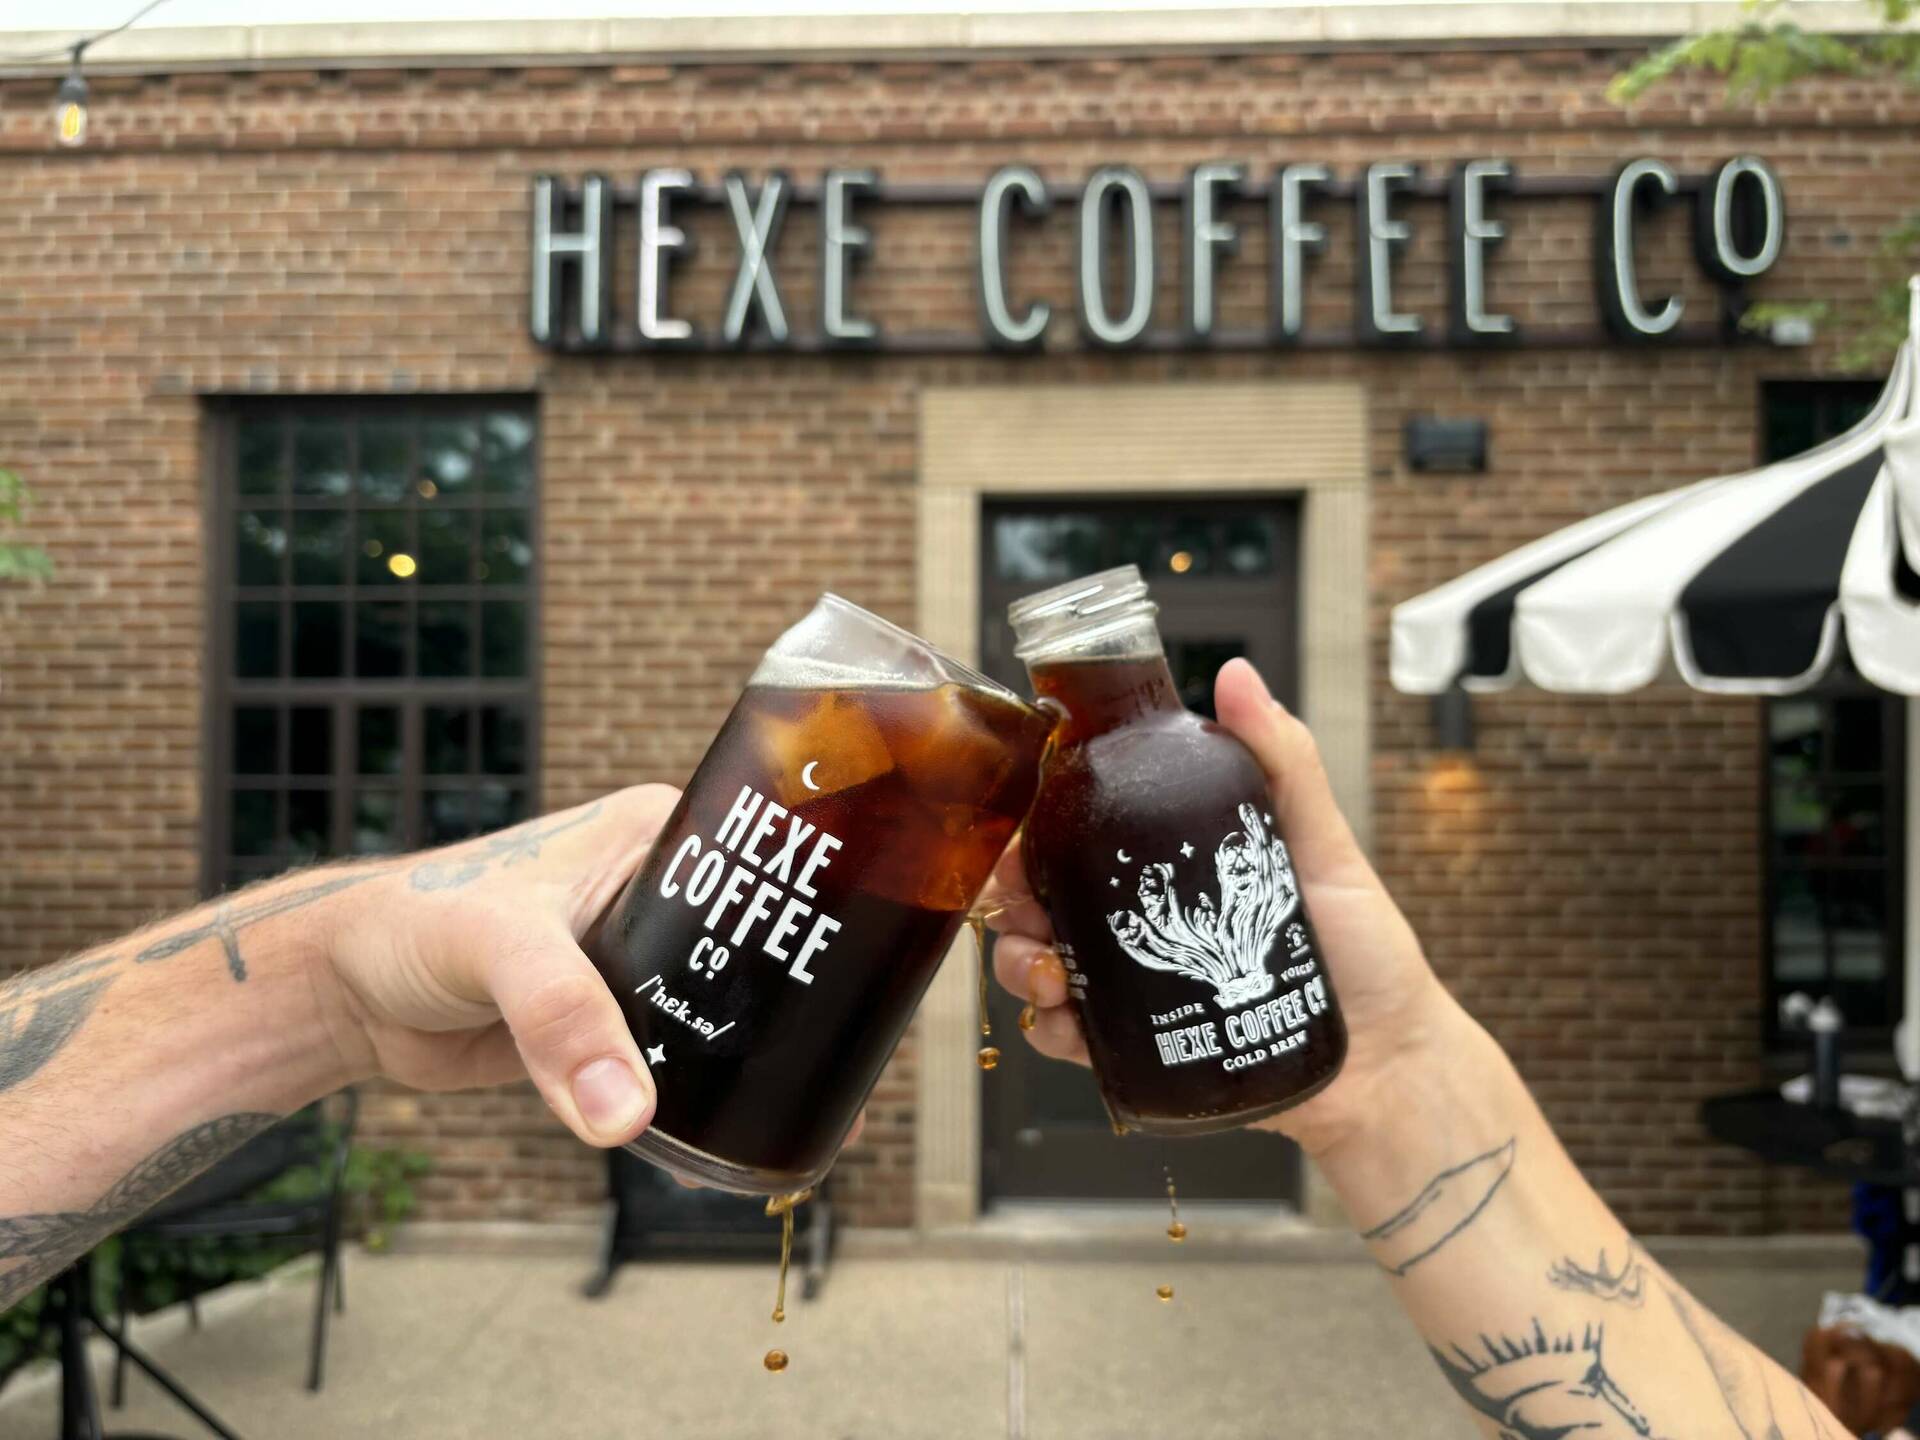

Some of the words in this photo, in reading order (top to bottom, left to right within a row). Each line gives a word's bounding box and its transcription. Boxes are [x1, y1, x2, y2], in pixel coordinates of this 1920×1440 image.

[531, 165, 876, 343] HEXE
[978, 157, 1517, 343] COFFEE
[714, 784, 844, 900] HEXE
[659, 833, 843, 986] COFFEE
[1150, 1002, 1206, 1026] INSIDE
[1154, 1020, 1224, 1067] HEXE
[1224, 988, 1310, 1050] COFFEE
[1222, 1048, 1268, 1073] COLD
[1269, 1029, 1308, 1058] BREW
